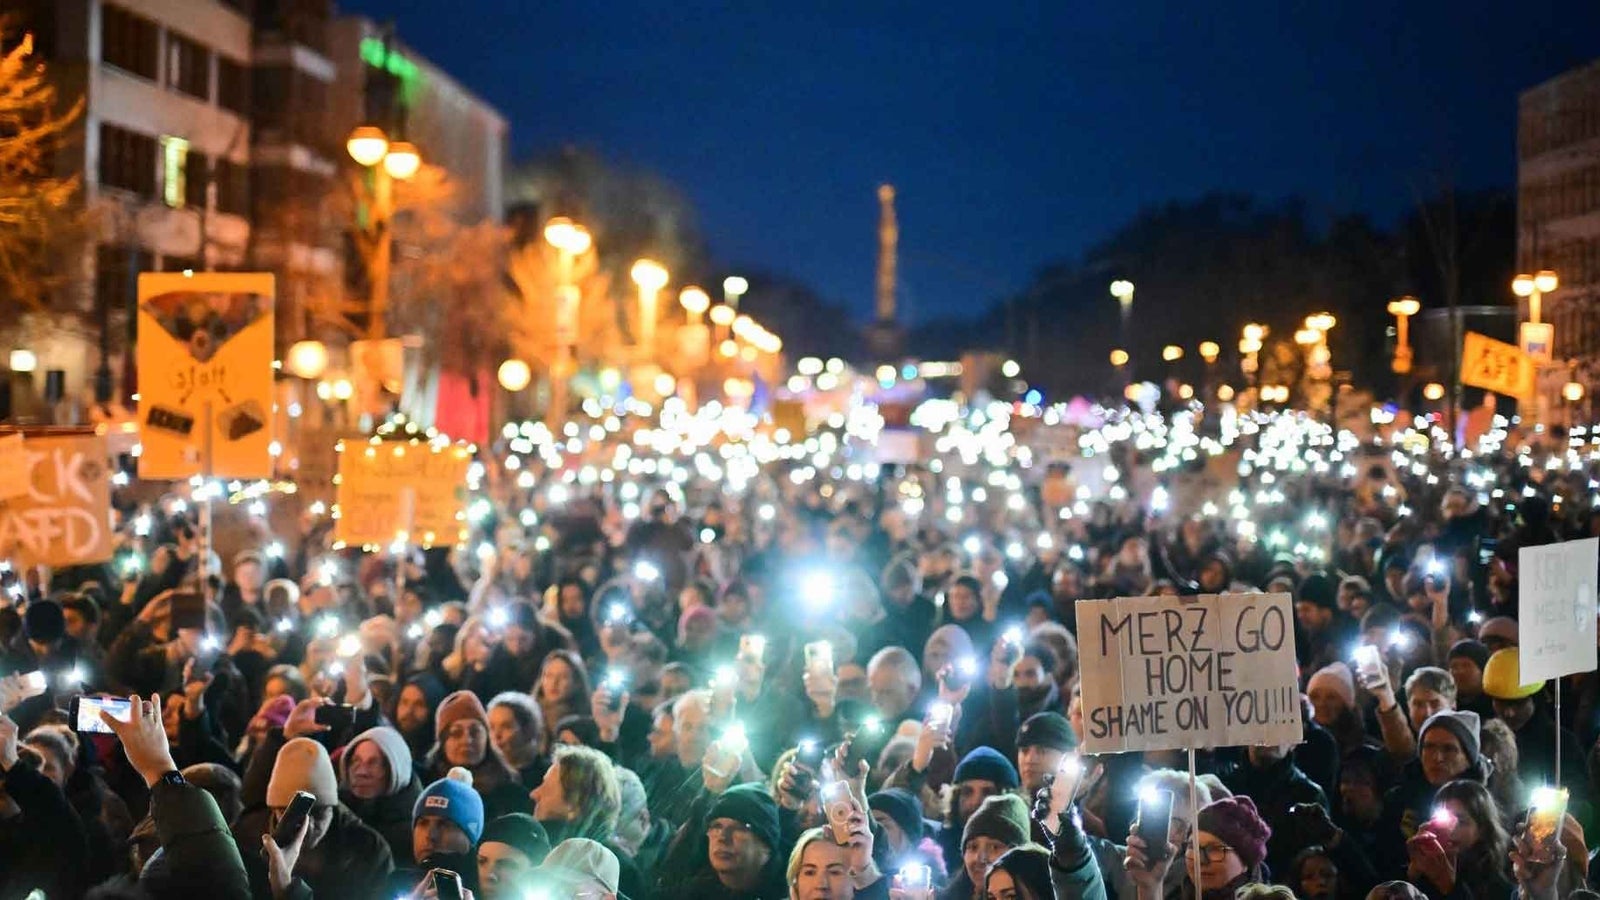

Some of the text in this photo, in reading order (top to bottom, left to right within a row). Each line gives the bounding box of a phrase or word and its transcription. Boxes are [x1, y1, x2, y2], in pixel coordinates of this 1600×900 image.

[26, 448, 95, 504] CK
[1101, 605, 1286, 656] MERZ GO
[1145, 652, 1236, 697] HOME
[1090, 686, 1295, 738] SHAME ON YOU!!!
